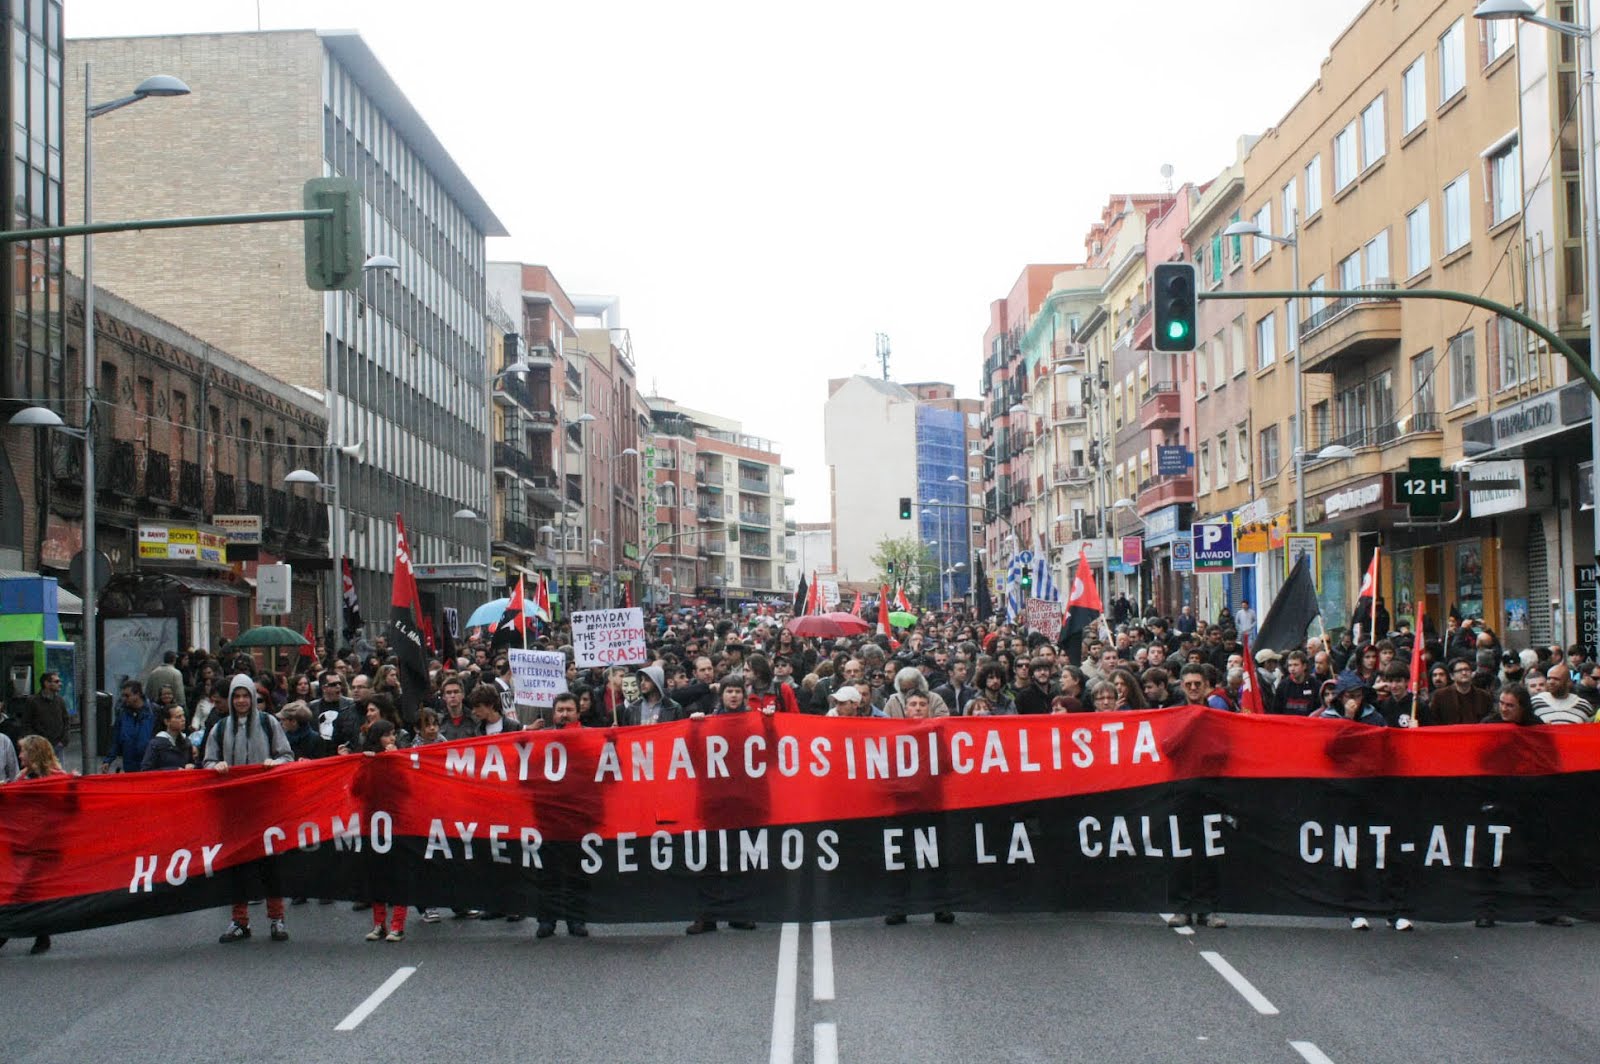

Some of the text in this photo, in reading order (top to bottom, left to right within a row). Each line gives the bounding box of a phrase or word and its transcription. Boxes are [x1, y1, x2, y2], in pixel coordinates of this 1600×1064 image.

[1403, 479, 1447, 495] 12 H
[147, 531, 166, 539] SANYO
[169, 532, 195, 540] SONY
[1203, 525, 1222, 550] P
[1195, 551, 1231, 559] LAVADO
[573, 611, 631, 624] #MAYDAY
[576, 628, 645, 642] THE SYSTEM
[584, 640, 631, 650] IS ABOUT
[582, 646, 647, 662] TO CRASH
[536, 693, 544, 701] DE
[445, 742, 568, 782] MAYO
[594, 720, 1160, 783] ANARCOSINDICALISTA
[128, 810, 1512, 894] HOY COMO AYER SEGUIMOS EN LA CALLE CNT-AIT
